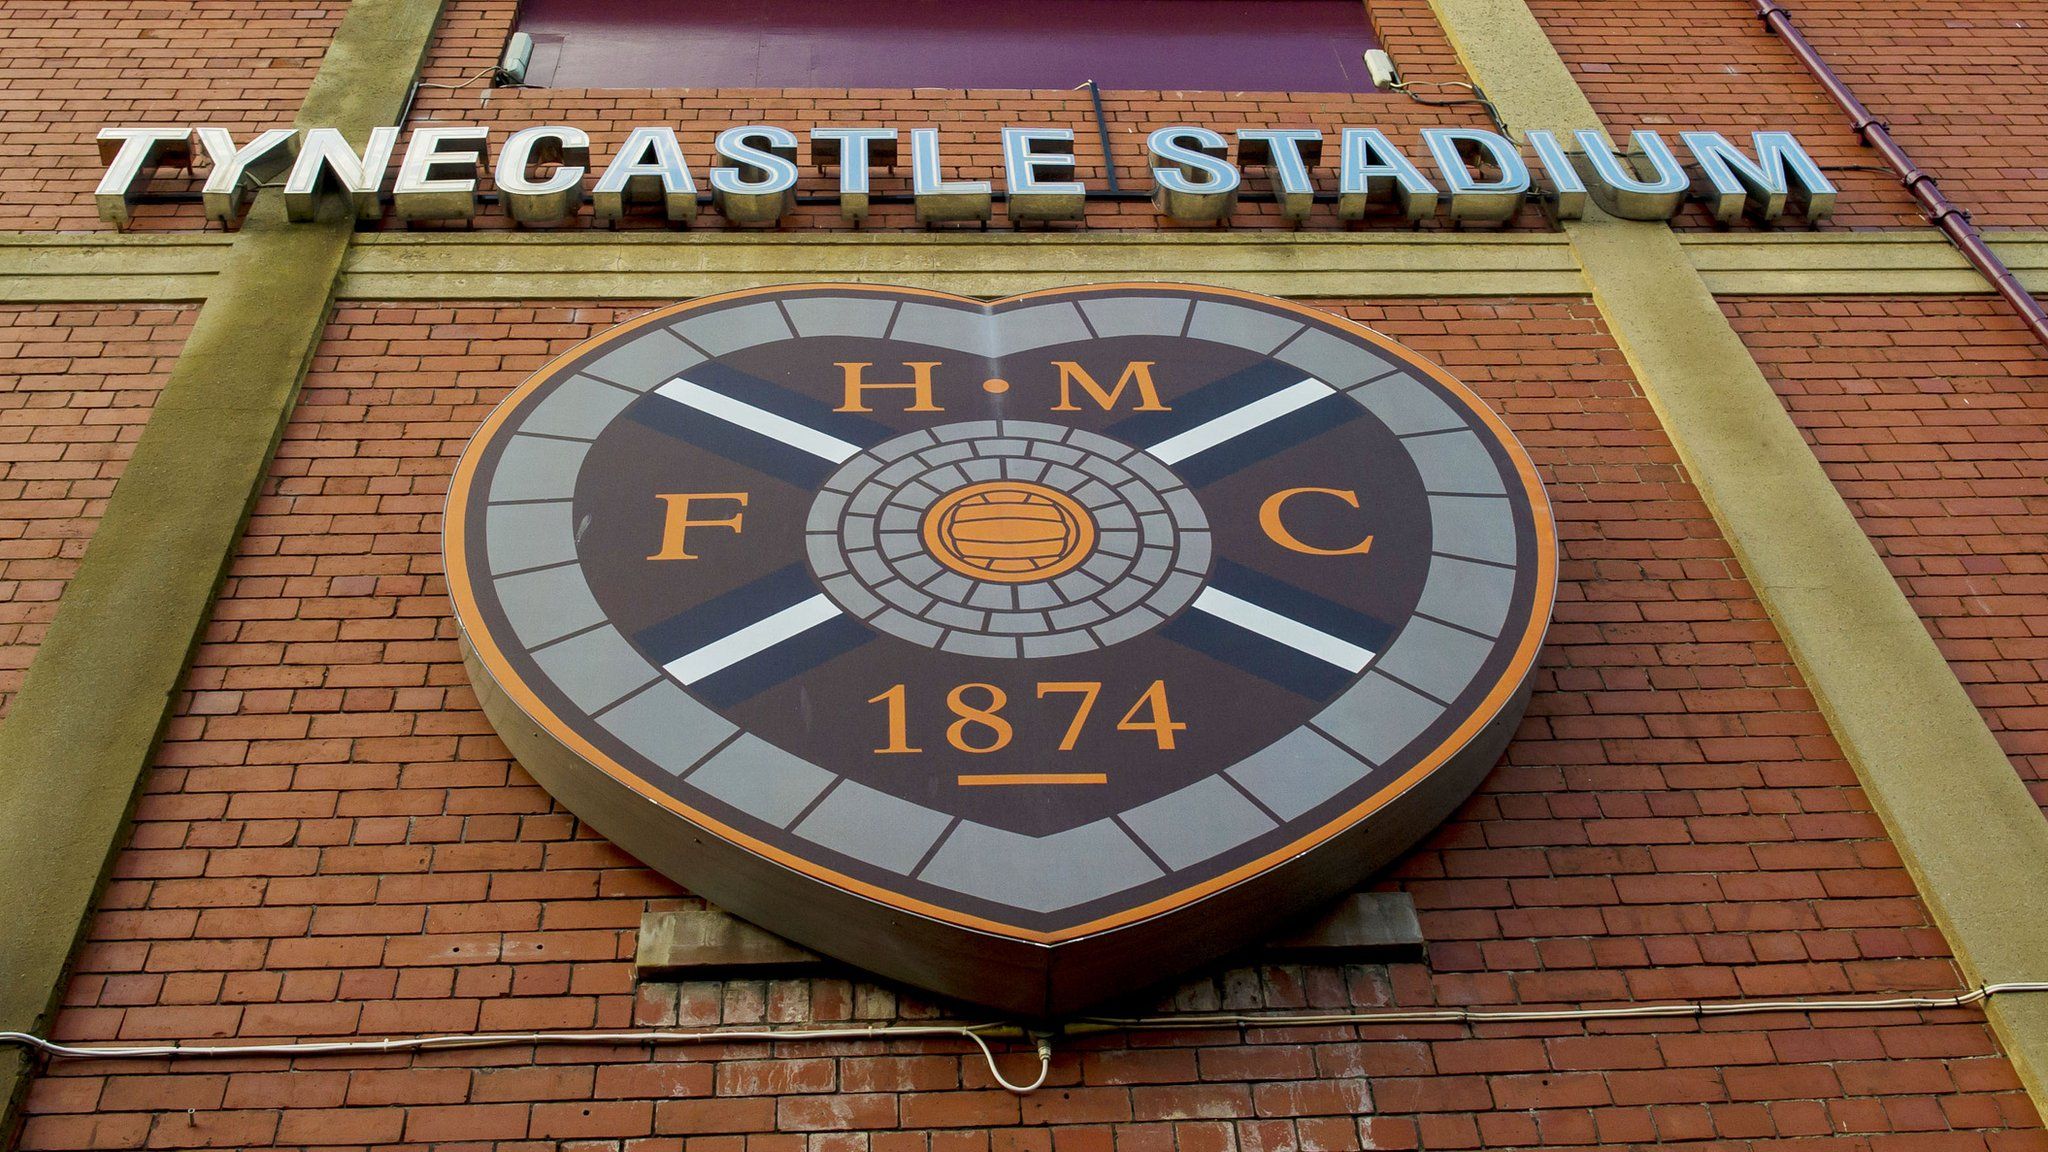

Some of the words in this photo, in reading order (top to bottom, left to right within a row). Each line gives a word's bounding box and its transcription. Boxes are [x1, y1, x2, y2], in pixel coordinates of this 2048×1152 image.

[94, 125, 1086, 200] TYNECASTLE
[1146, 125, 1838, 200] STADIUM
[832, 361, 946, 413] H
[1050, 360, 1172, 412] M
[646, 492, 749, 561] F
[1258, 487, 1375, 556] C
[866, 679, 1187, 755] 1874
